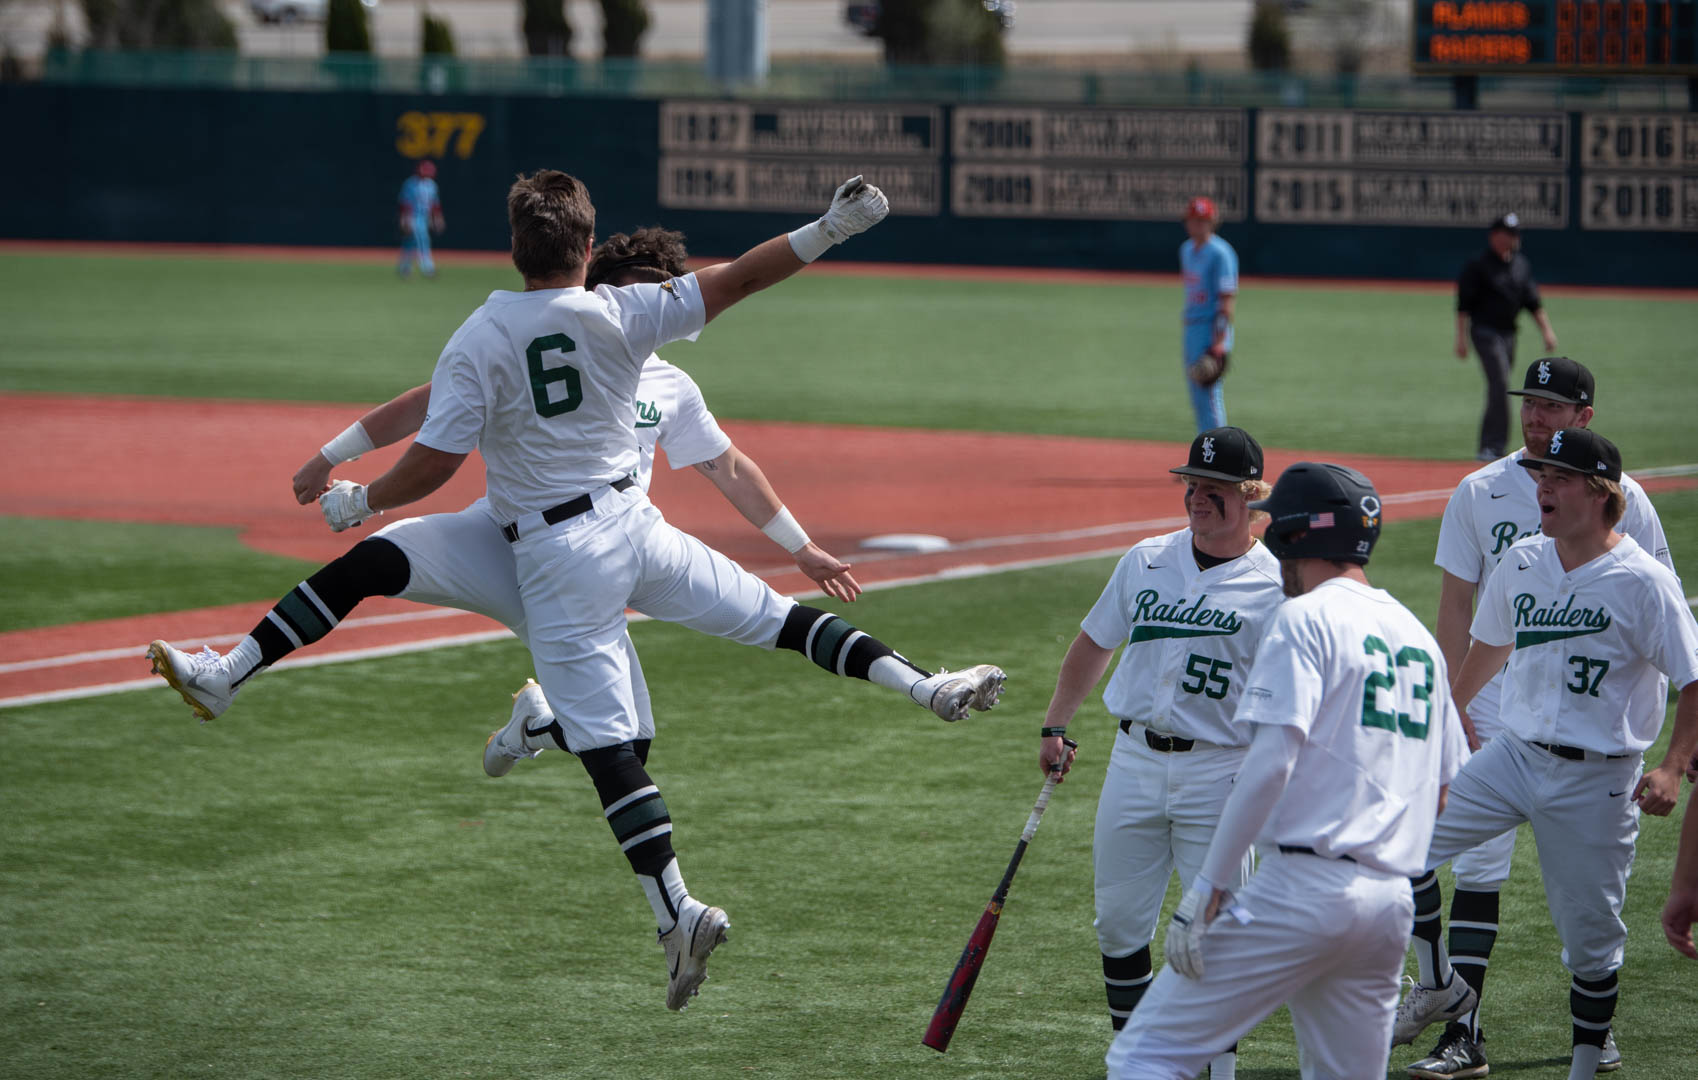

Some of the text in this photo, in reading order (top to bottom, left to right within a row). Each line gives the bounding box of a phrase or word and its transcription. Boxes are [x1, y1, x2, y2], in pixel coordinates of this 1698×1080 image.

[395, 111, 486, 158] 377
[1267, 121, 1343, 154] 2011
[1591, 125, 1674, 159] 2016
[1266, 178, 1343, 212] 2015
[1591, 184, 1674, 219] 2018
[525, 332, 583, 418] 6
[1132, 589, 1242, 636] Raiders
[1514, 592, 1611, 633] Raiders
[1182, 653, 1233, 700] 55
[1362, 634, 1434, 742] 23
[1567, 655, 1610, 697] 37
